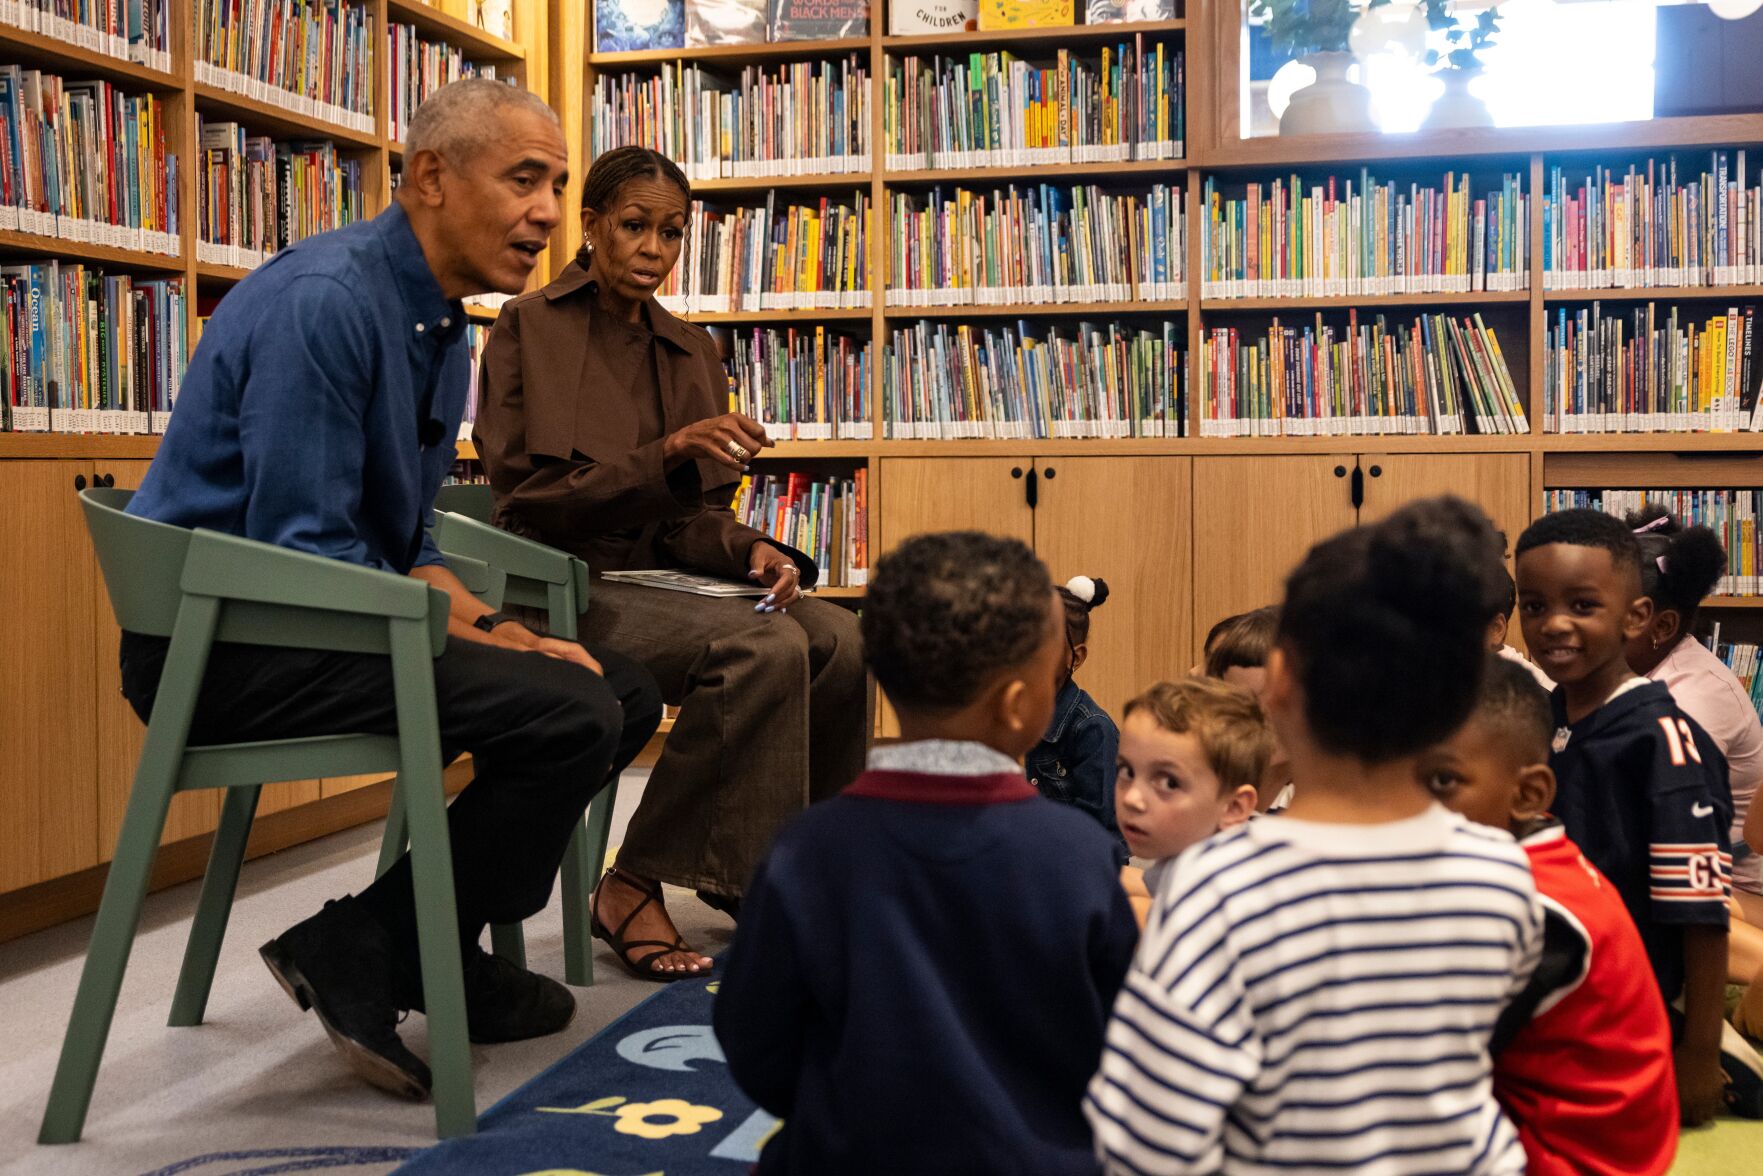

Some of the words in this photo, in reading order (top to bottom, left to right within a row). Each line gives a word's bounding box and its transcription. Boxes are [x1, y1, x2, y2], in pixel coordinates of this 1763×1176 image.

[790, 6, 828, 19] BLACK
[916, 9, 967, 28] CHILDREN
[31, 288, 40, 331] Ocean
[1744, 317, 1752, 355] TIMELINES
